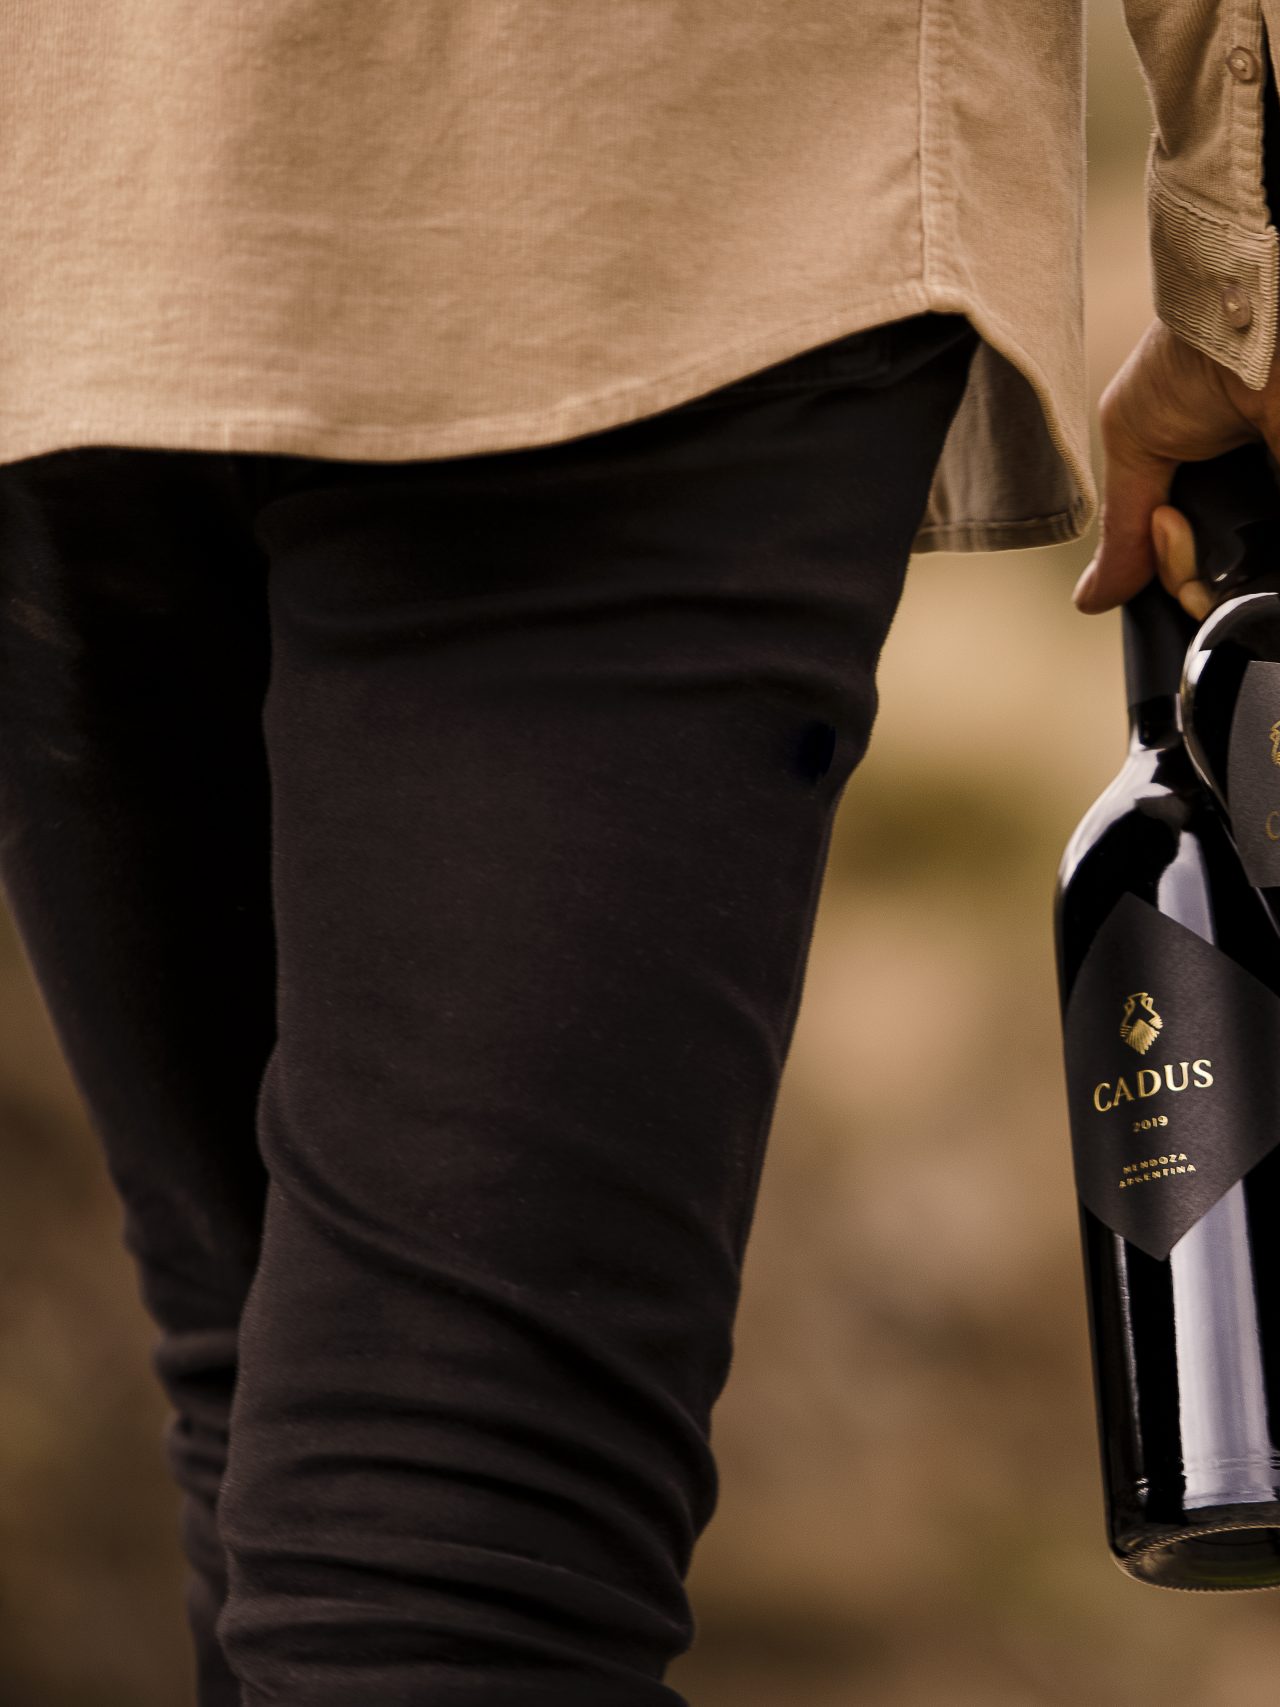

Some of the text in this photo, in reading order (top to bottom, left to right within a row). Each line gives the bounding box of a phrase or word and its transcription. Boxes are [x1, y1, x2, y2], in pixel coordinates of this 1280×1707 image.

[1093, 1059, 1214, 1112] CADUS
[1133, 1115, 1169, 1133] 2019
[1122, 1153, 1188, 1174] MENDOZA
[1119, 1164, 1197, 1188] ARGENTINA
